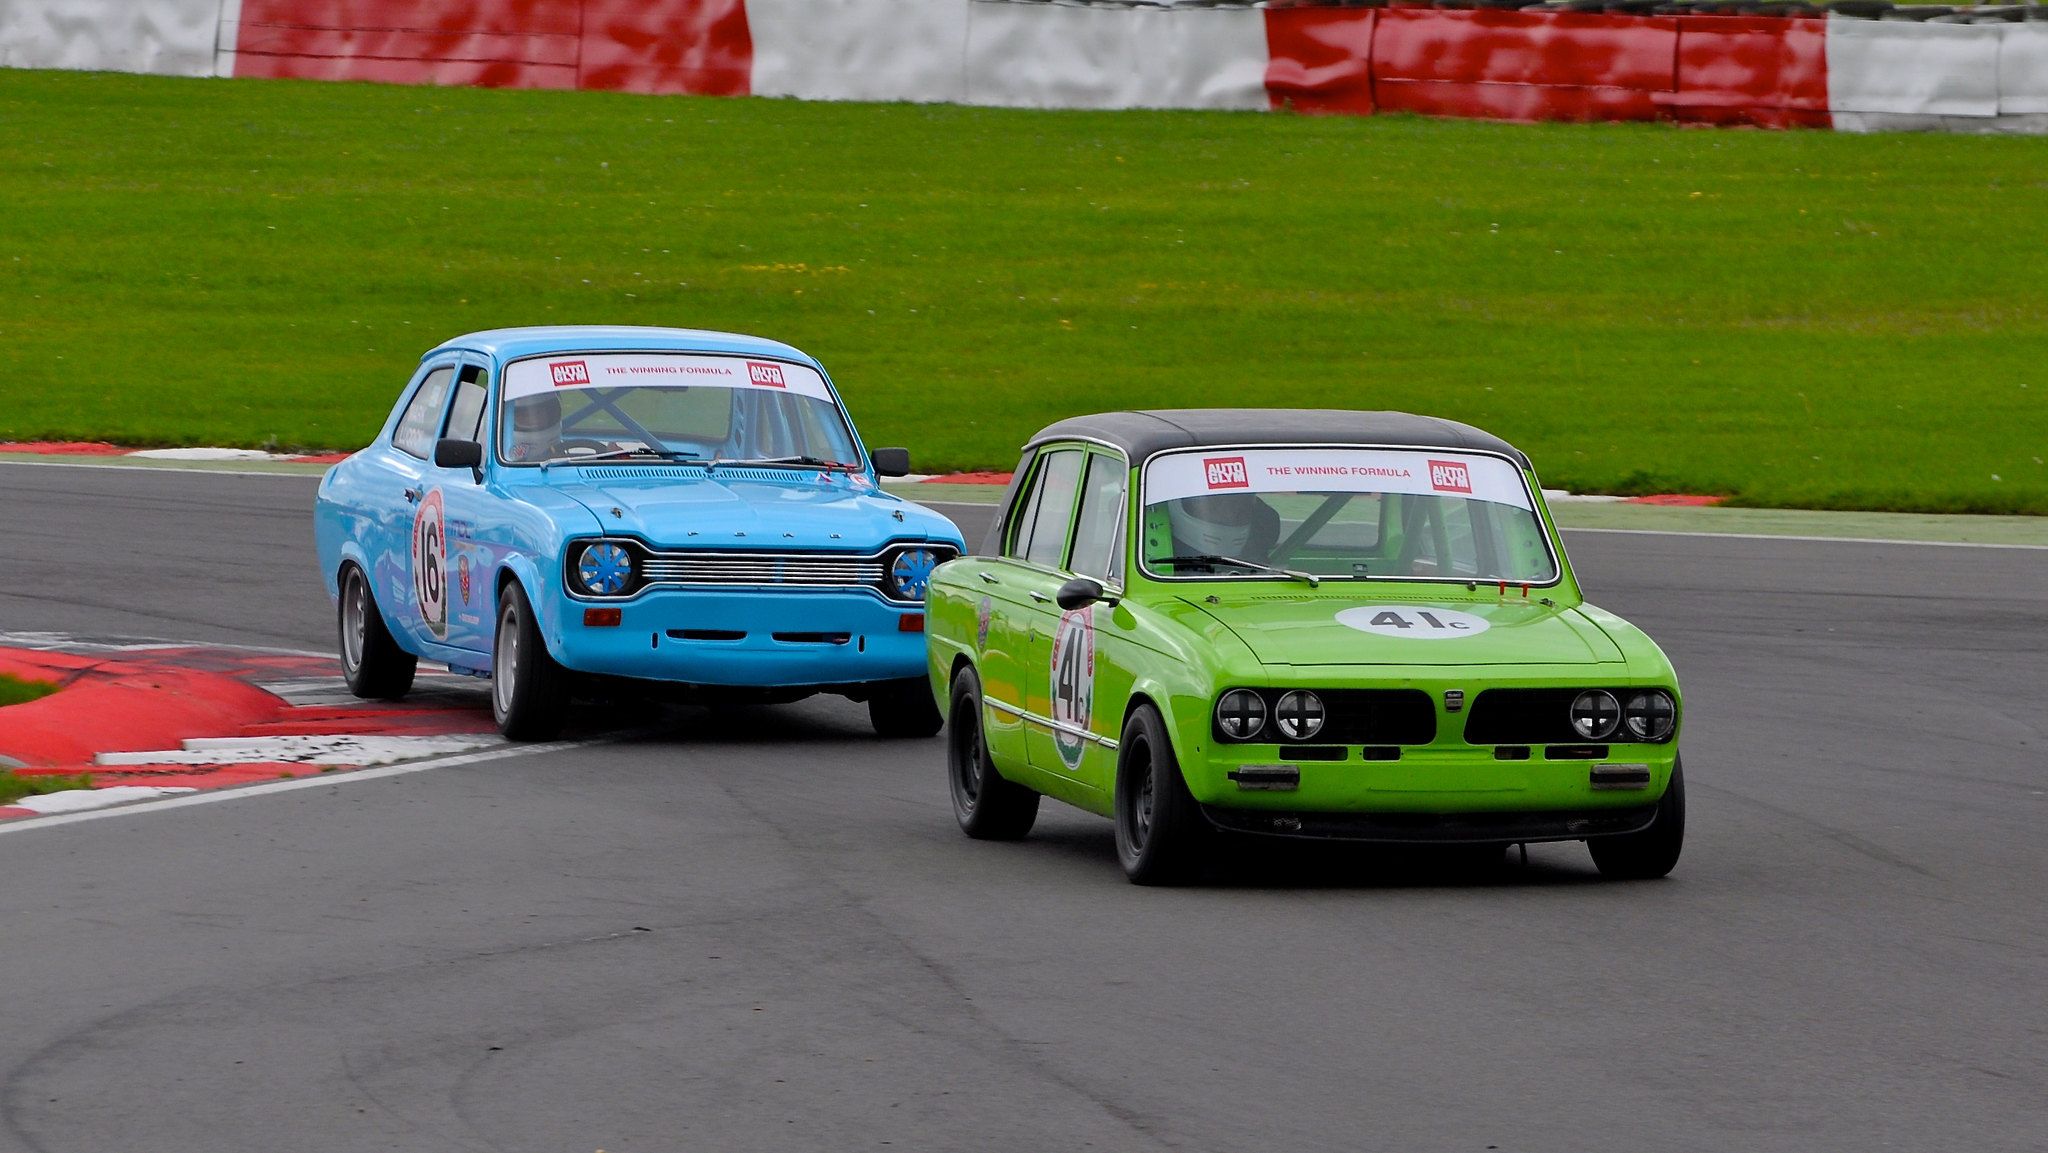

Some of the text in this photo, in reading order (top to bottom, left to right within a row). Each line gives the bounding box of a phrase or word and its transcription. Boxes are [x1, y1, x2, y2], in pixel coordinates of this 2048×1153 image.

[606, 366, 732, 375] THE WINNING FORMULA
[1208, 461, 1242, 473] AUTO
[1266, 466, 1411, 477] THE WINNING FORMULA
[1432, 465, 1466, 477] AUTO
[1208, 470, 1245, 485] GLYM
[421, 520, 439, 604] 16
